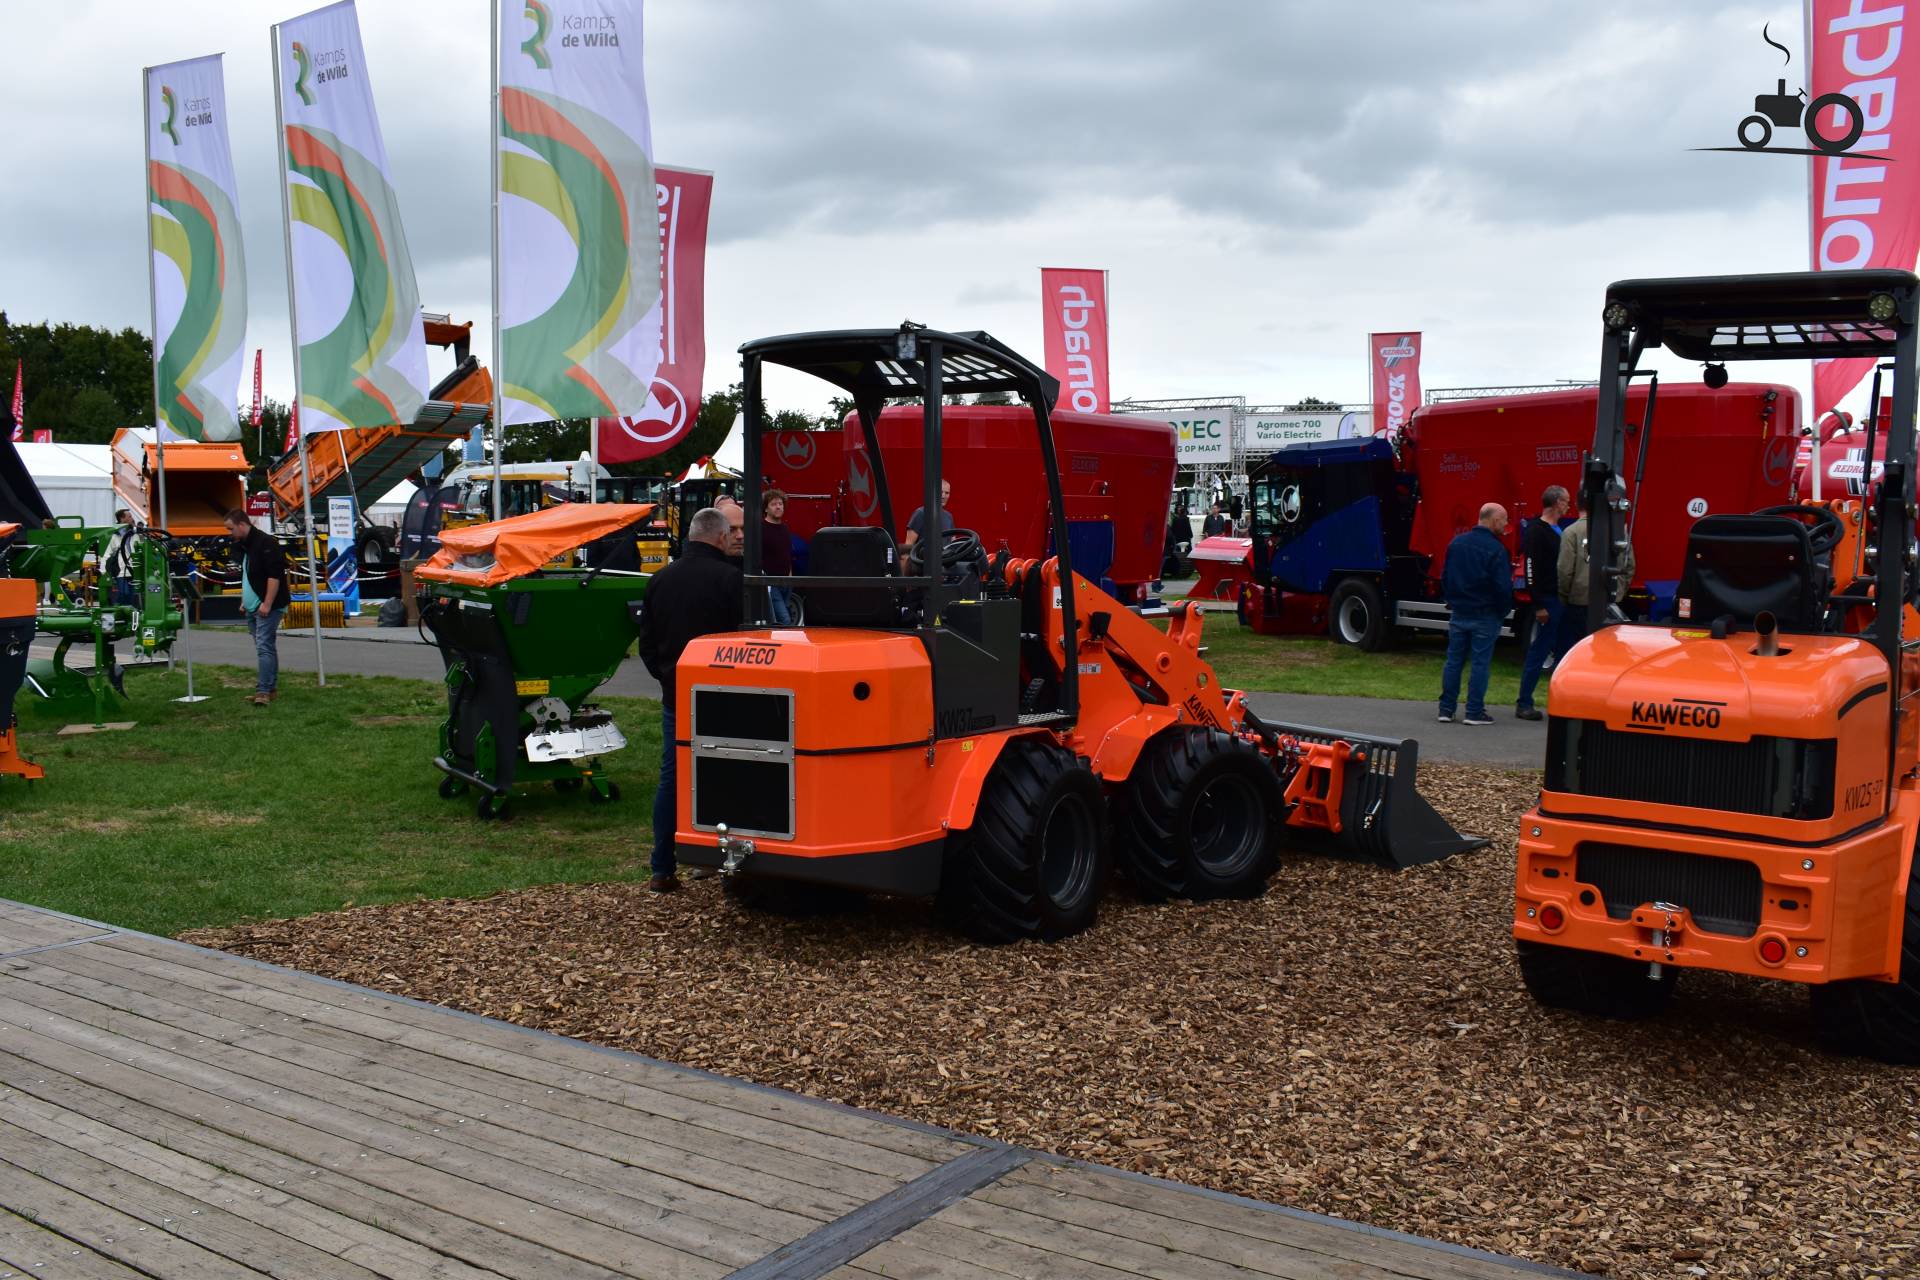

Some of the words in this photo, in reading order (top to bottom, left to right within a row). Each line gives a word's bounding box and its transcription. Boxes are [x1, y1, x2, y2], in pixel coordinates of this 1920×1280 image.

[562, 15, 616, 32] Kamps
[561, 33, 579, 47] de
[583, 32, 619, 47] Wild
[314, 49, 346, 66] Kamps
[317, 71, 326, 84] de
[326, 64, 348, 81] Wild
[185, 115, 197, 127] de
[1819, 0, 1904, 271] omach
[1256, 420, 1301, 430] Agromec
[1303, 420, 1321, 428] 700
[1257, 431, 1281, 439] Vario
[1284, 430, 1322, 439] Electric
[1198, 444, 1222, 453] MAAT
[1833, 464, 1880, 474] REDROK
[1691, 502, 1704, 514] 40
[713, 645, 777, 666] KAWECO
[1631, 700, 1721, 729] KAWECO
